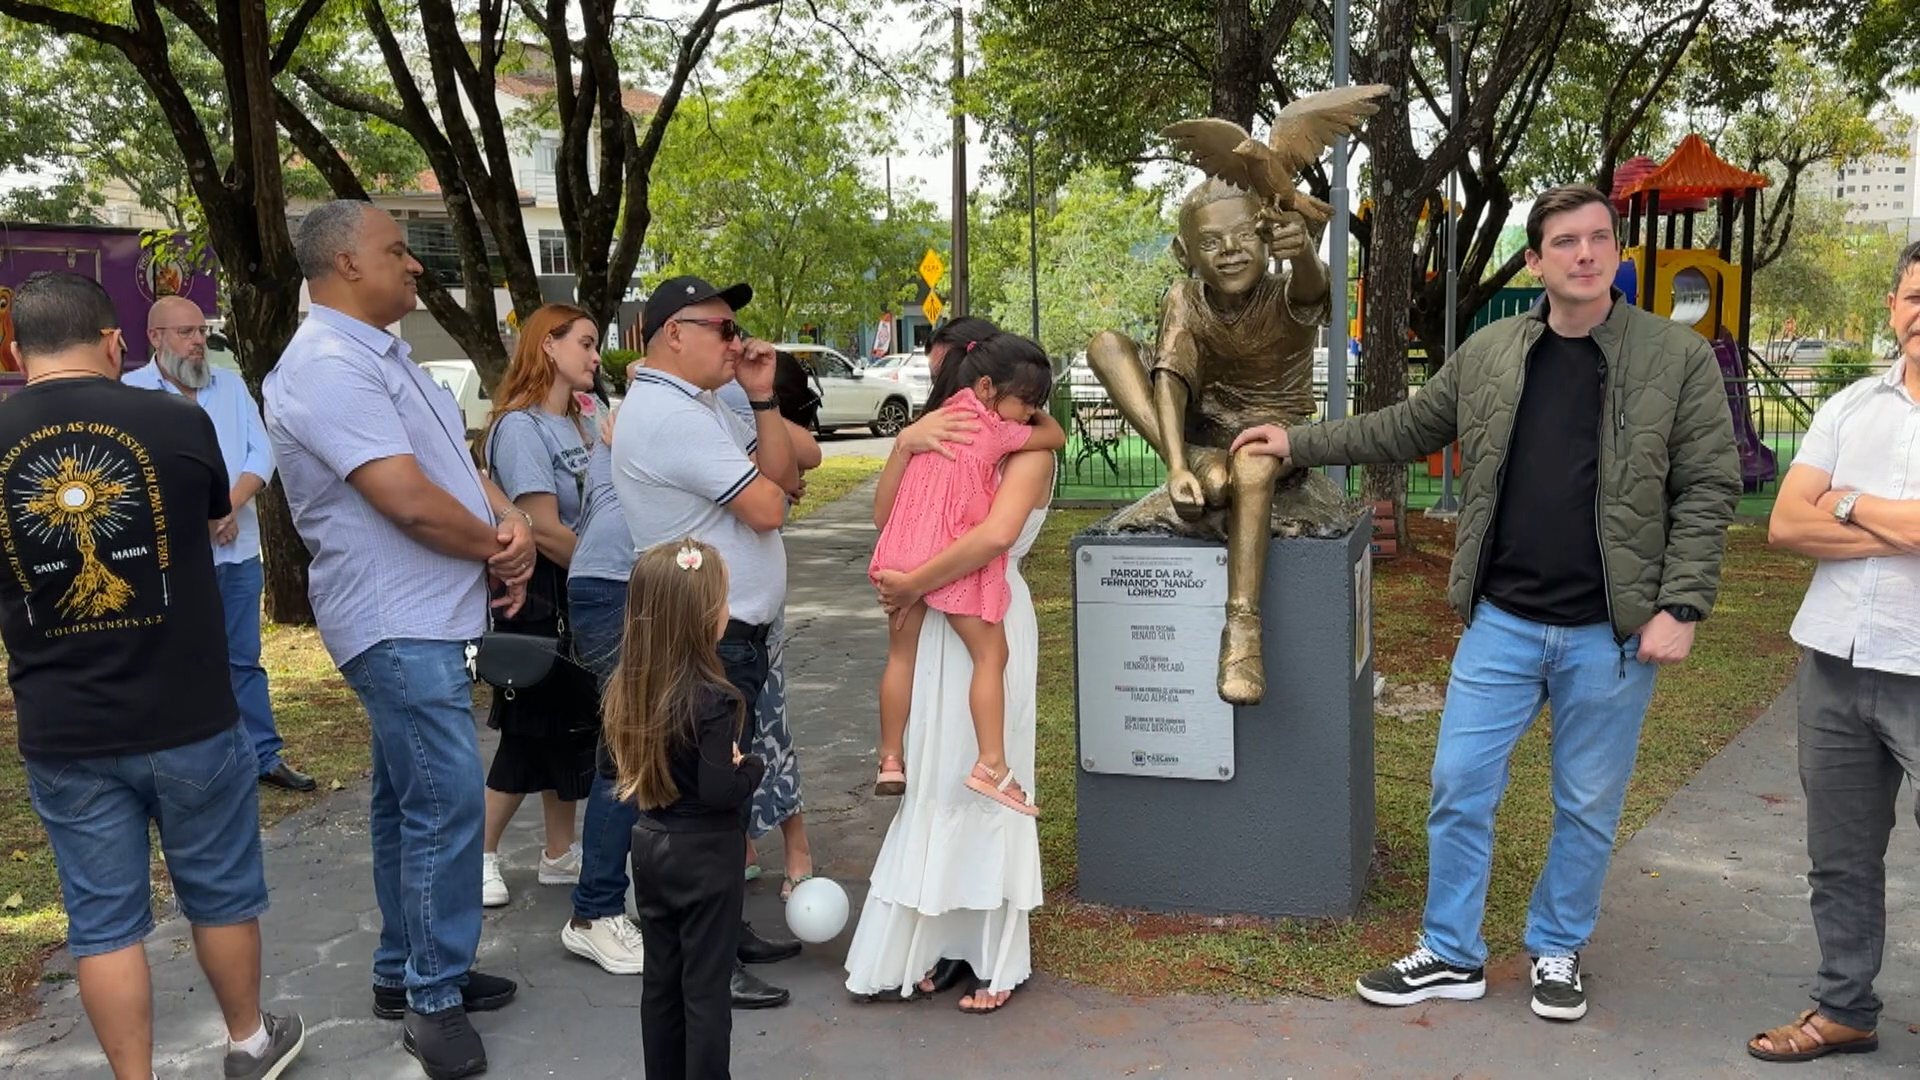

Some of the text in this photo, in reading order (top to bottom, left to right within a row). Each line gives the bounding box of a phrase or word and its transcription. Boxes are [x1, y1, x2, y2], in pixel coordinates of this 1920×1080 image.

[30, 424, 62, 442] NÃO
[66, 421, 84, 433] AS
[88, 422, 118, 438] QUE
[116, 432, 150, 464] ESTÃO
[111, 546, 148, 561] MARIA
[33, 559, 68, 575] SALVE
[1110, 569, 1193, 579] PARQUE DA PAZ
[1100, 578, 1159, 588] FERNANDO
[1127, 588, 1177, 598] LORENZO
[45, 617, 139, 639] COLOSSENSES
[1131, 631, 1175, 641] RENATO SILVA
[1123, 661, 1156, 672] HENRIQUE
[1130, 692, 1179, 703] TIAGO ALMEIDA
